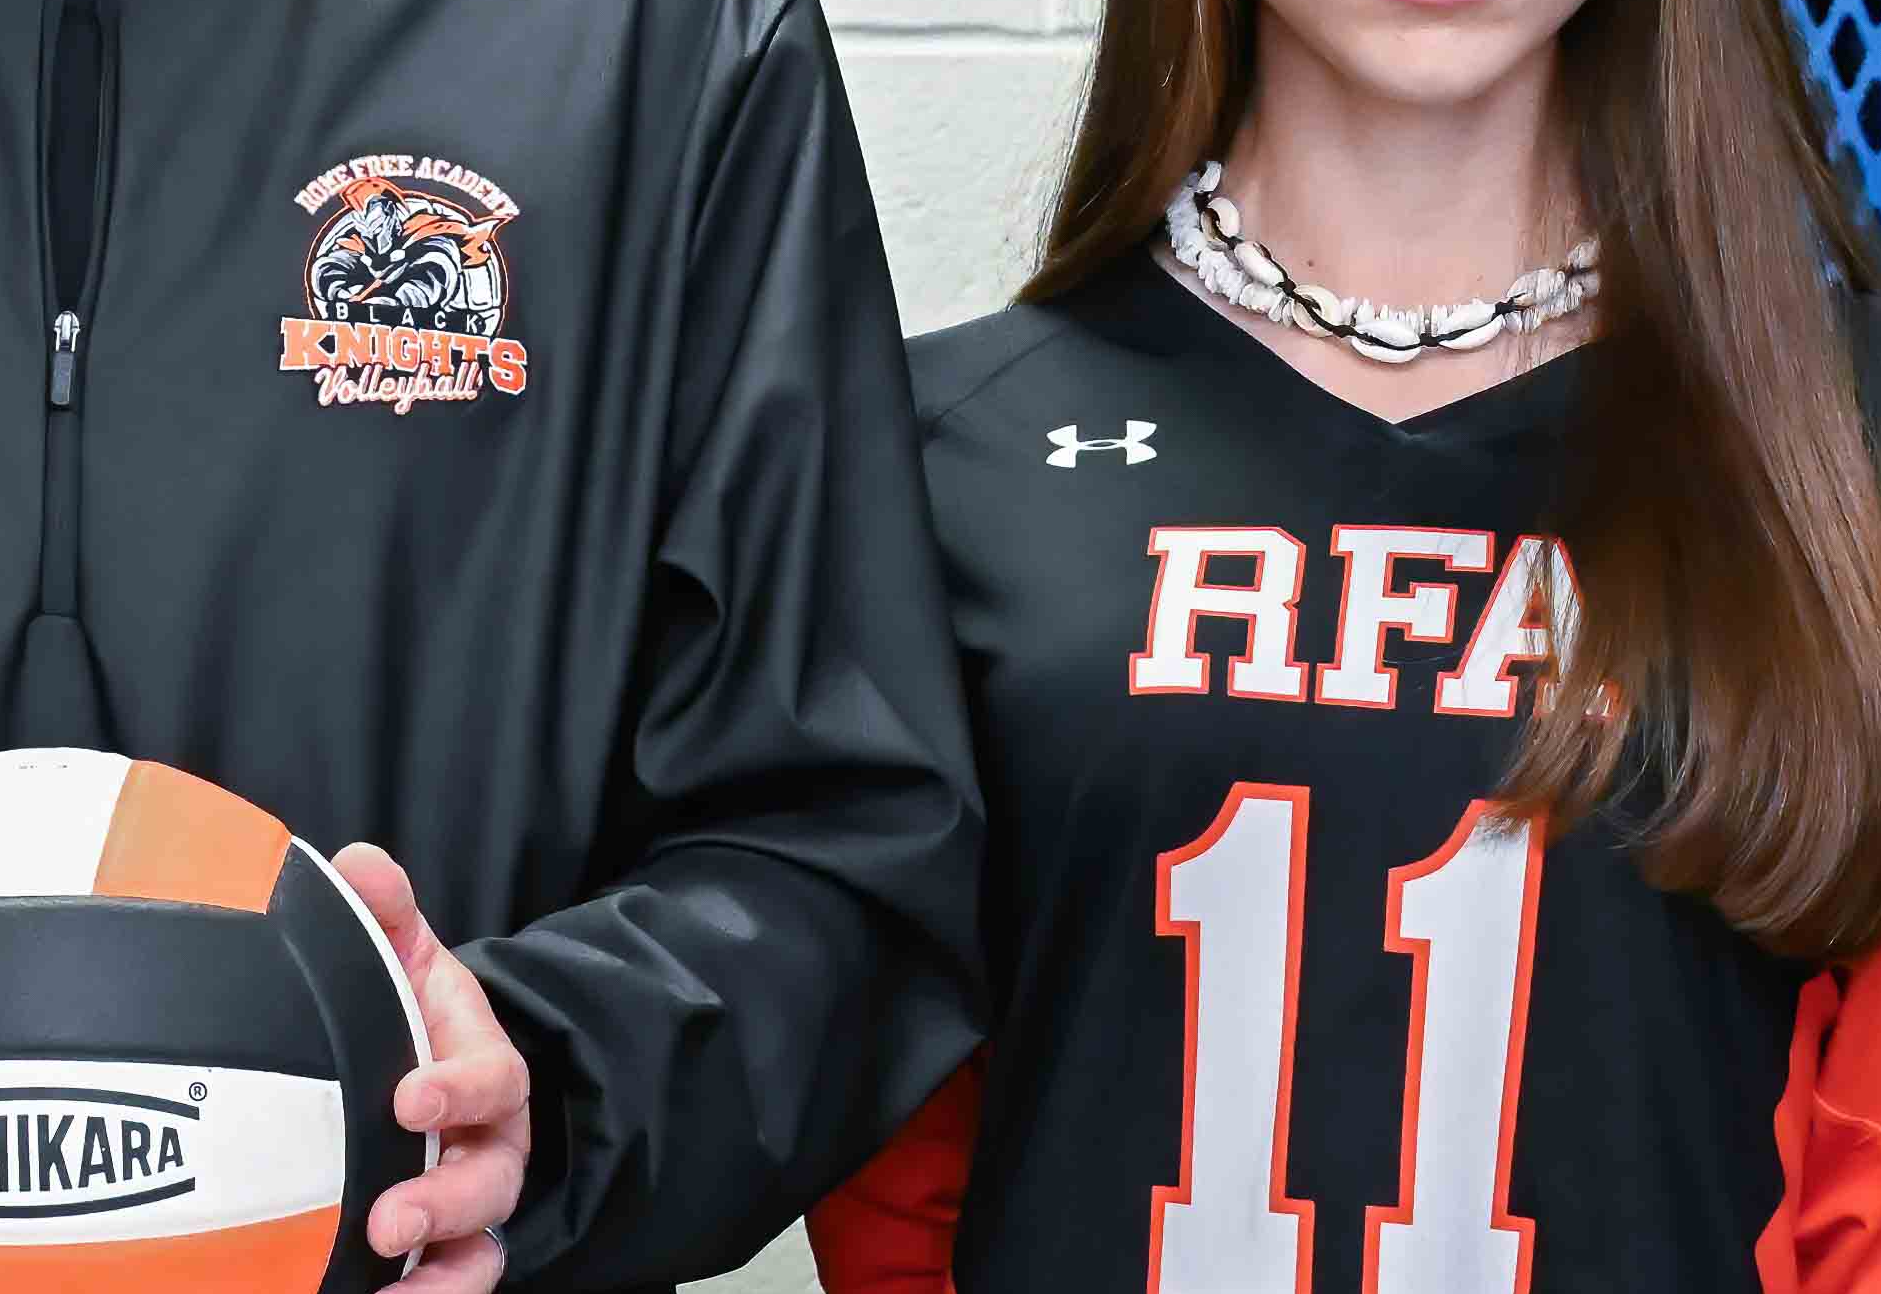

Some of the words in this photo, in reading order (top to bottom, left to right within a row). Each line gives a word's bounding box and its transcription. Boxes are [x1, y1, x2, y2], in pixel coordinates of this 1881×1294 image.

[349, 155, 413, 178] FREE
[415, 157, 520, 216] ACADEMY
[336, 306, 478, 333] BLACK
[280, 317, 527, 395] KNIGHTS
[314, 361, 483, 415] Volleyball
[1129, 523, 1620, 718] RFA
